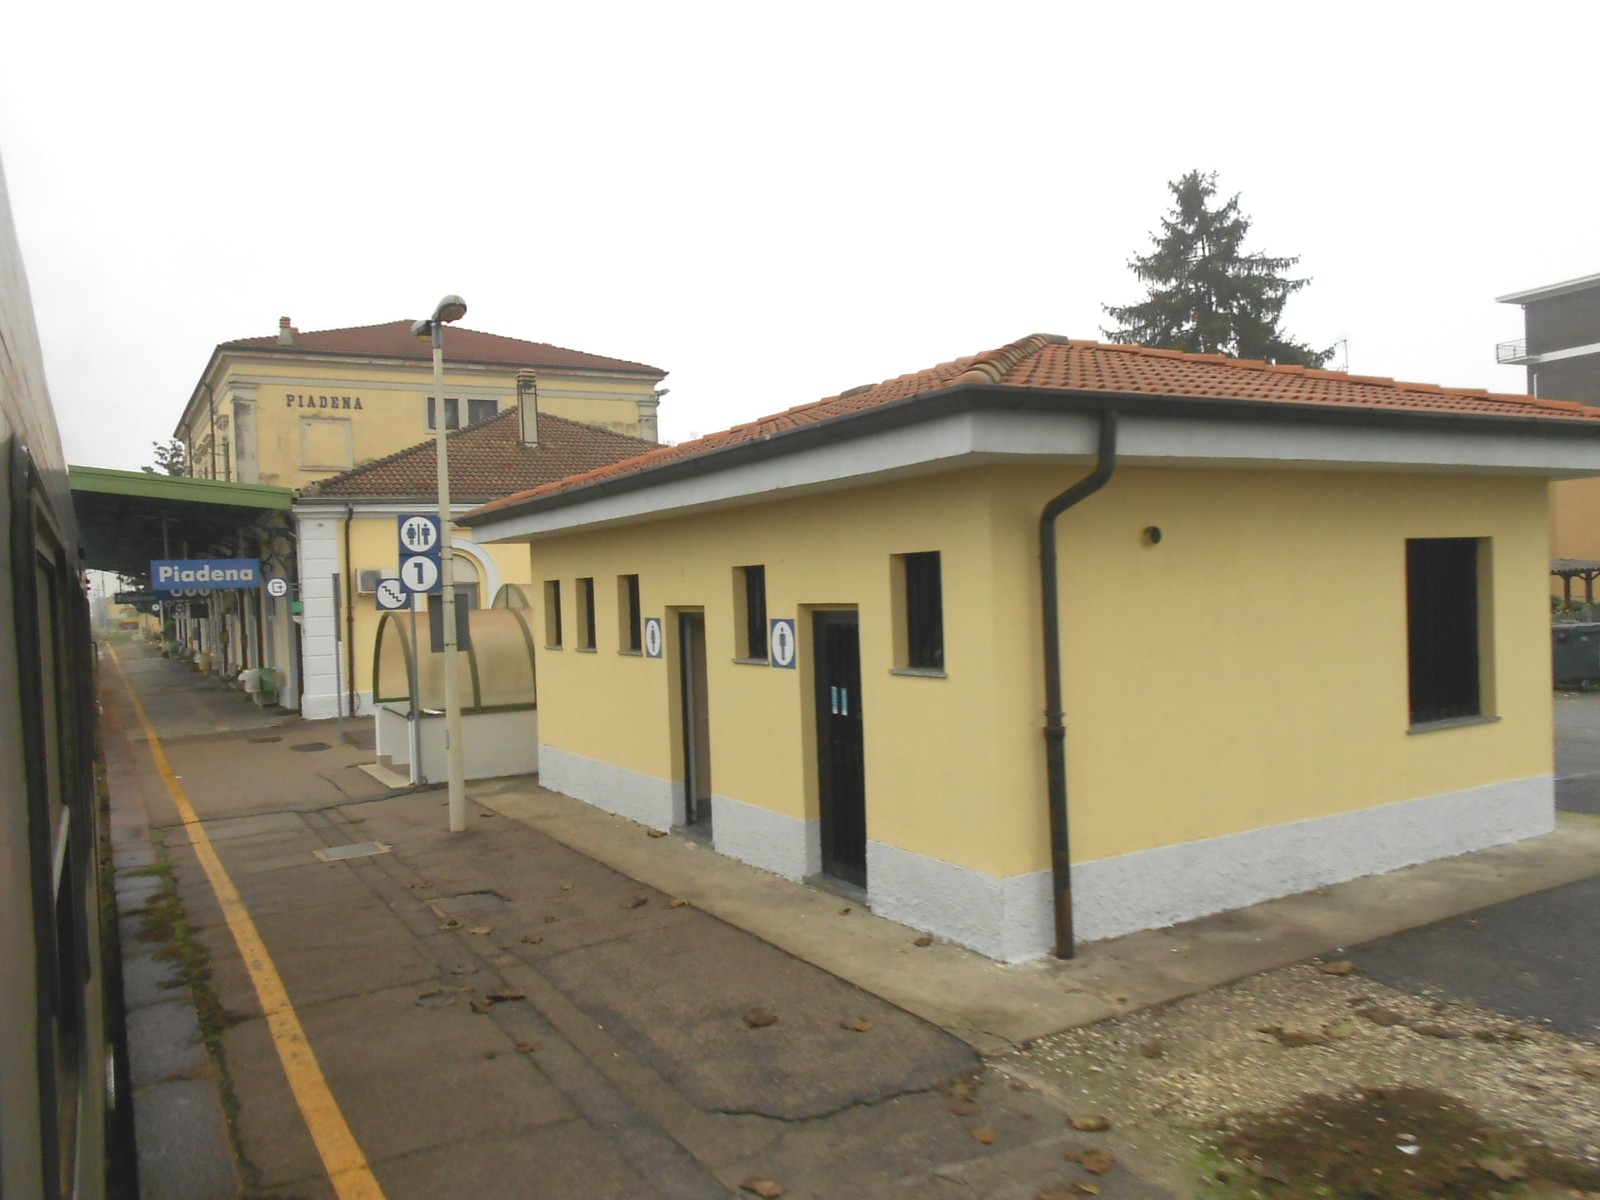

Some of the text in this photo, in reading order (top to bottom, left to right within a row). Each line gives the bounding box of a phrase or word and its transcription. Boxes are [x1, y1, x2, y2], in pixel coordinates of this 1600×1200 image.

[286, 394, 363, 410] PIADENA
[158, 564, 254, 583] Piadena
[413, 562, 424, 585] 1
